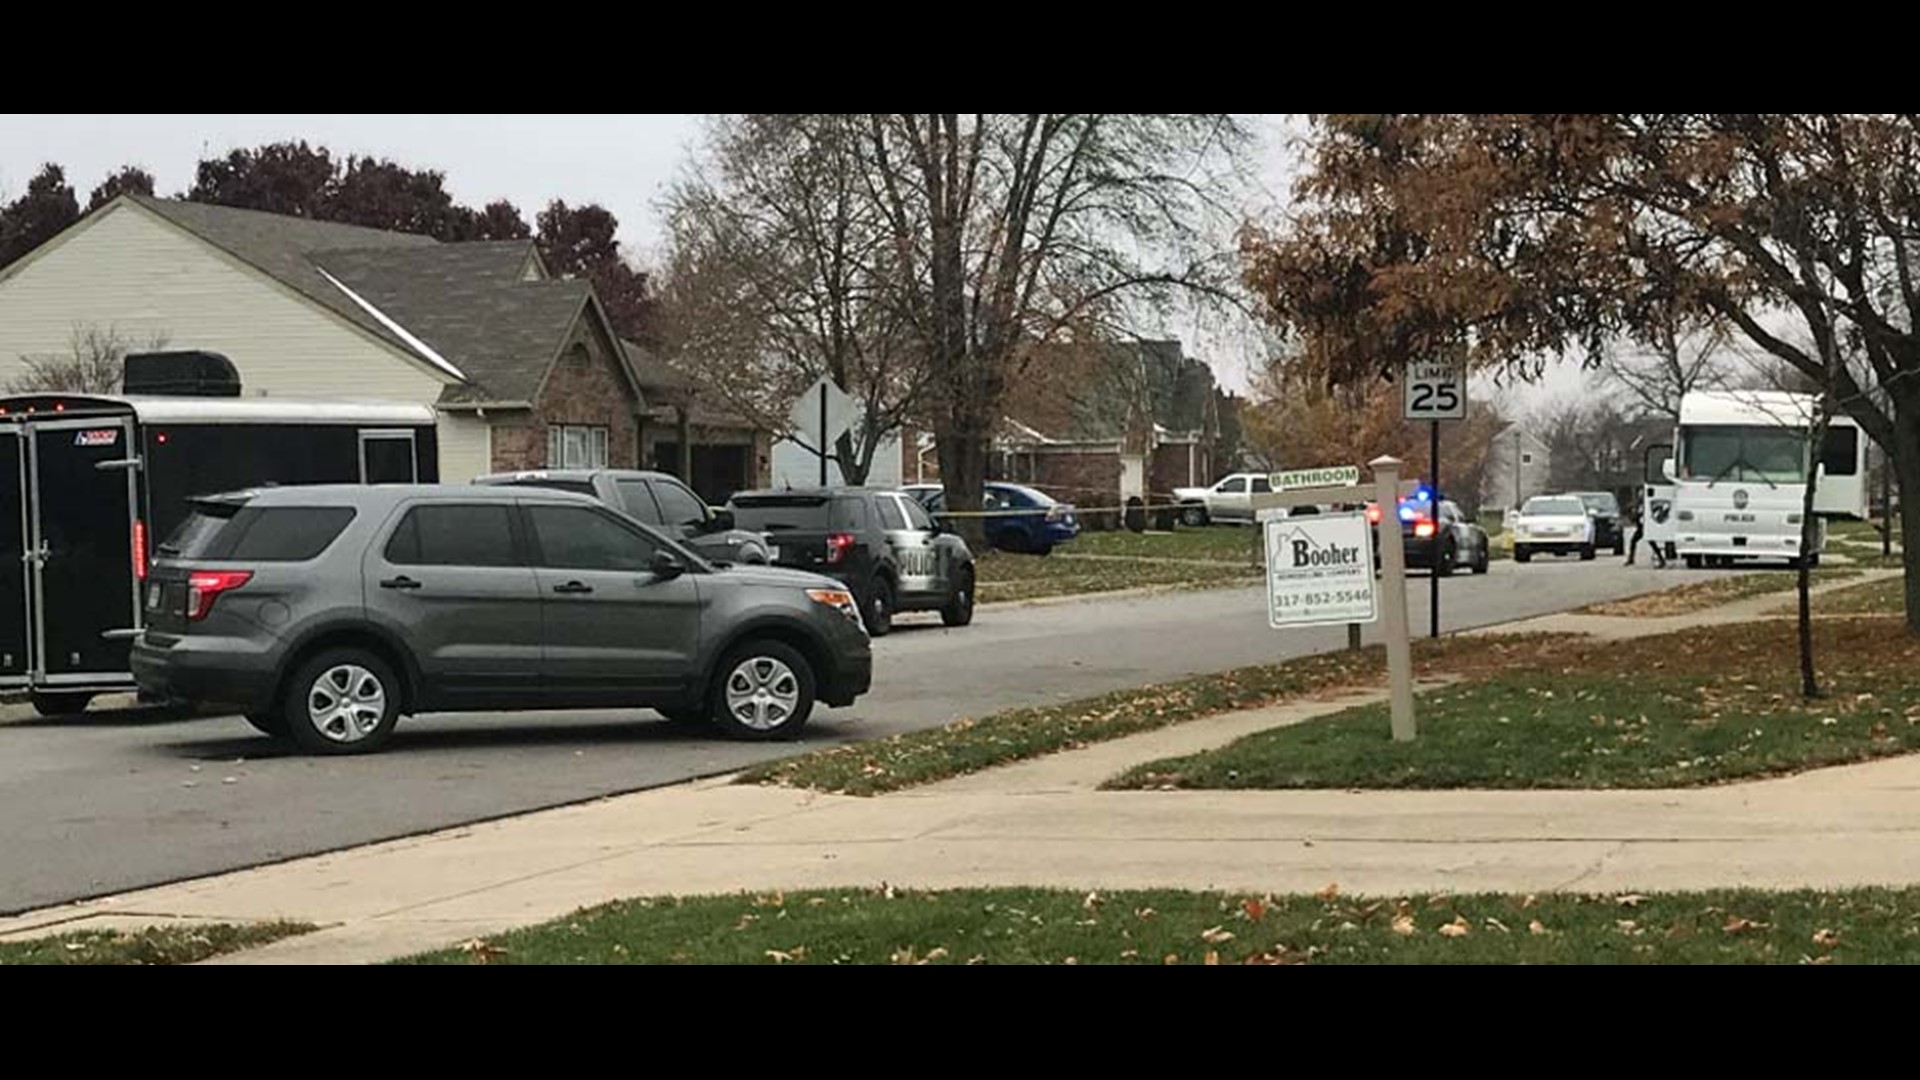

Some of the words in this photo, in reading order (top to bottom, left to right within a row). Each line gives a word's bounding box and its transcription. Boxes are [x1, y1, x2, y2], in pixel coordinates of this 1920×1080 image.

[1411, 383, 1458, 411] 25
[1271, 469, 1356, 486] BATHROOM
[1292, 540, 1358, 567] Booher
[1275, 589, 1372, 607] 317-852-5546
